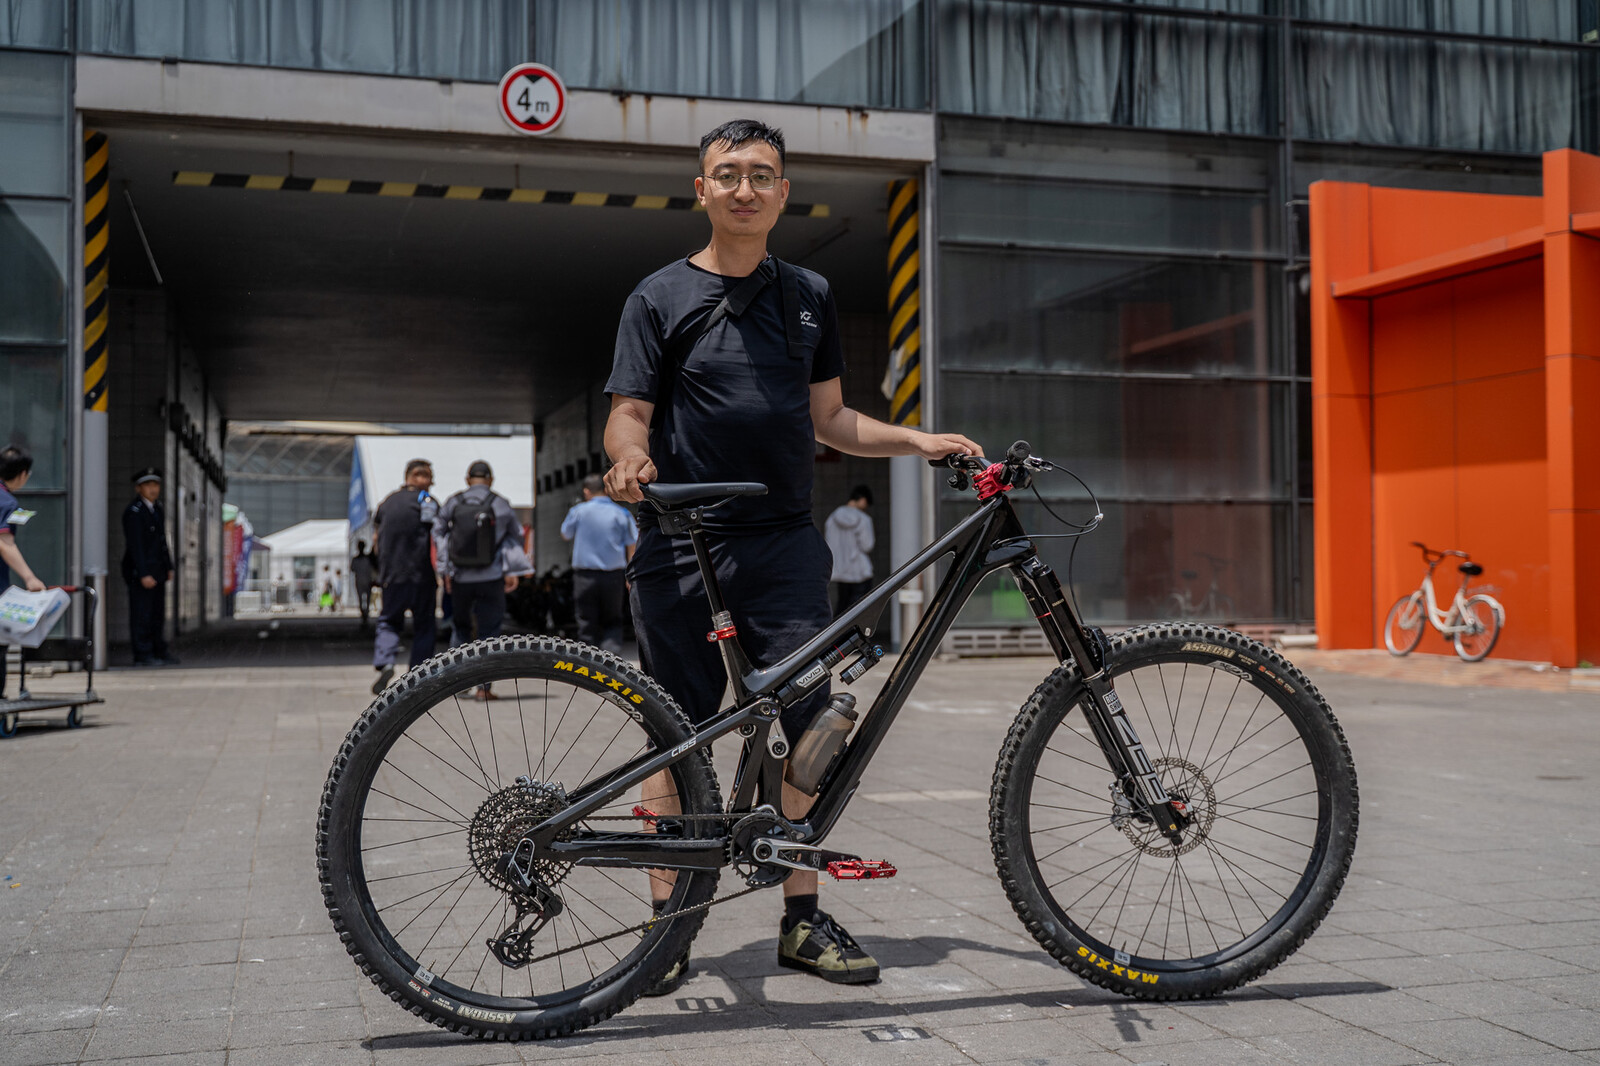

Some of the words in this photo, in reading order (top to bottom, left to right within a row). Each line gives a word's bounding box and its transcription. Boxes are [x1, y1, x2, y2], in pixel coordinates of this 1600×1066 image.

[1181, 641, 1236, 659] ASSEGAI
[553, 660, 645, 705] MAXXIS
[798, 667, 821, 685] VIVID
[1112, 713, 1170, 805] ZEB
[1076, 946, 1159, 984] MAXXIS
[457, 1004, 517, 1024] ASSEGAI
